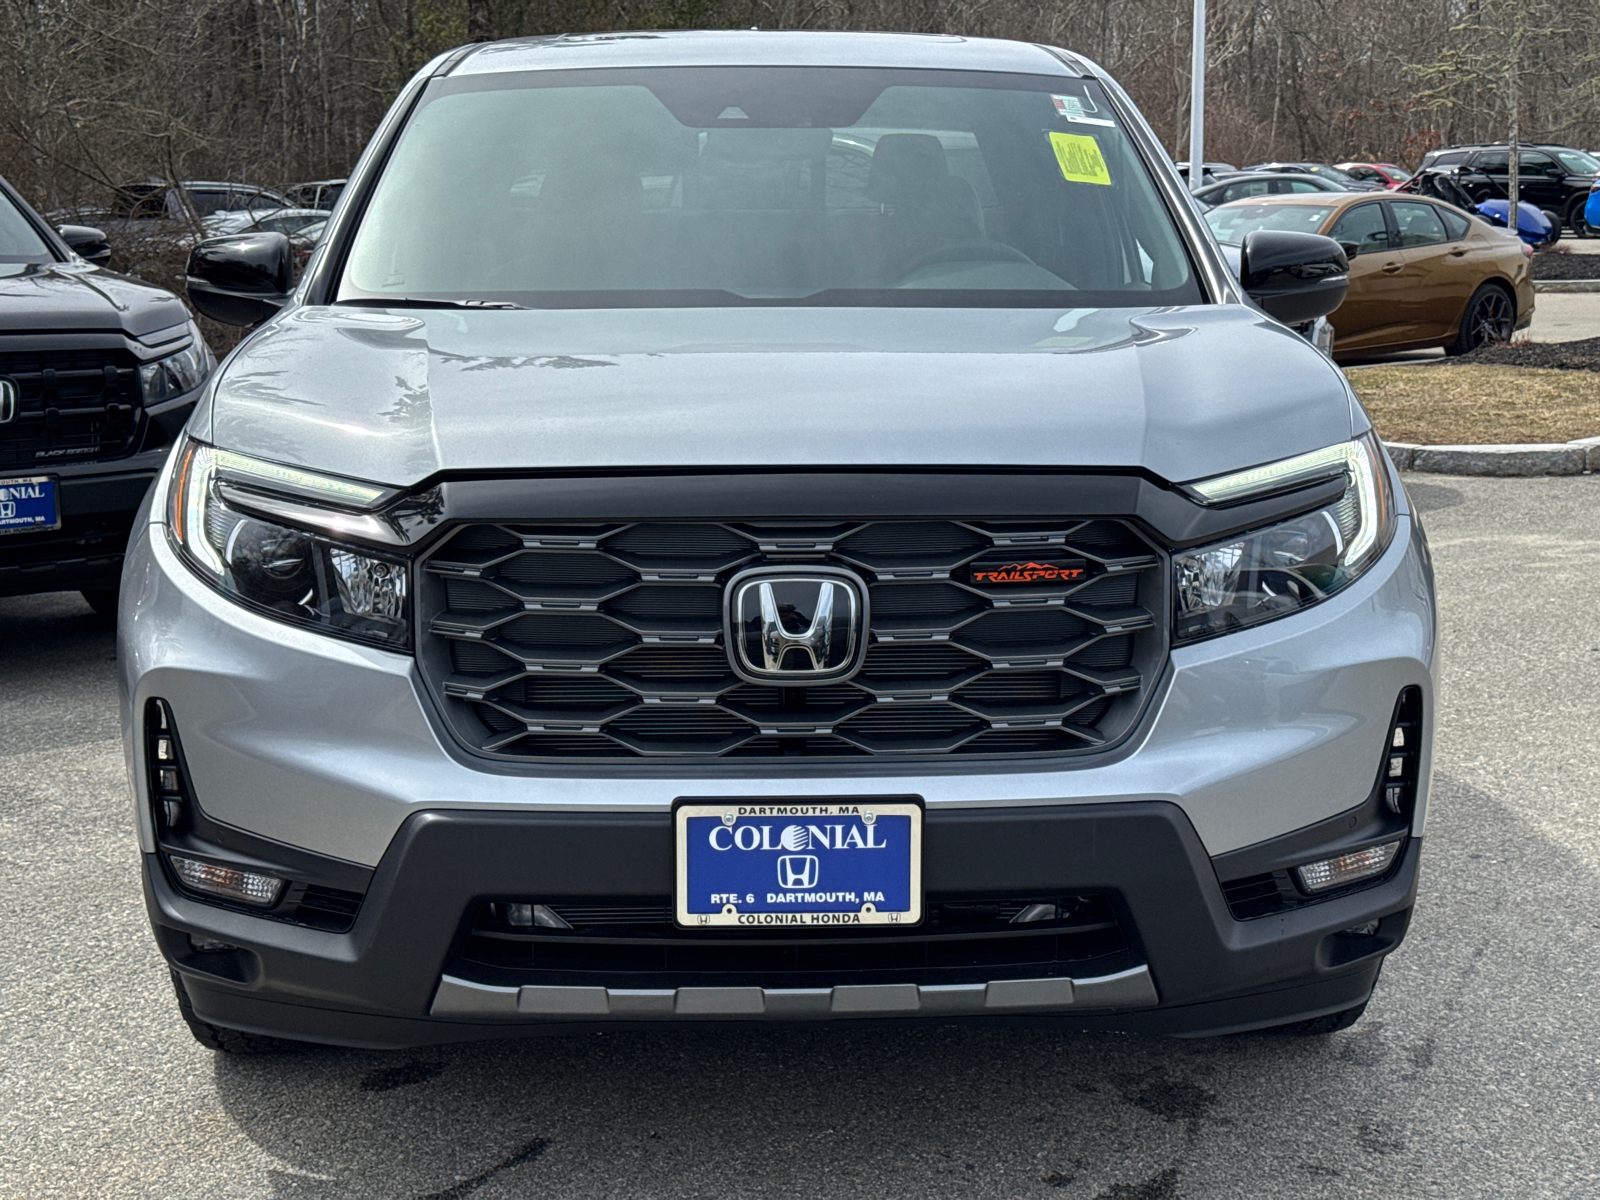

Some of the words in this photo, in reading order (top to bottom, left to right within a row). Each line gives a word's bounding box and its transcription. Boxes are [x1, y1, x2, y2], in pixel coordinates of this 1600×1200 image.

[973, 569, 1084, 583] TRAILSPORT
[838, 806, 860, 815] MA
[708, 824, 887, 852] COLONIAL
[711, 894, 743, 904] RTE.
[746, 894, 755, 904] 6
[766, 892, 860, 904] DARTMOUTH,
[863, 891, 885, 902] MA
[738, 914, 807, 925] COLONIAL
[811, 914, 861, 924] HONDA
